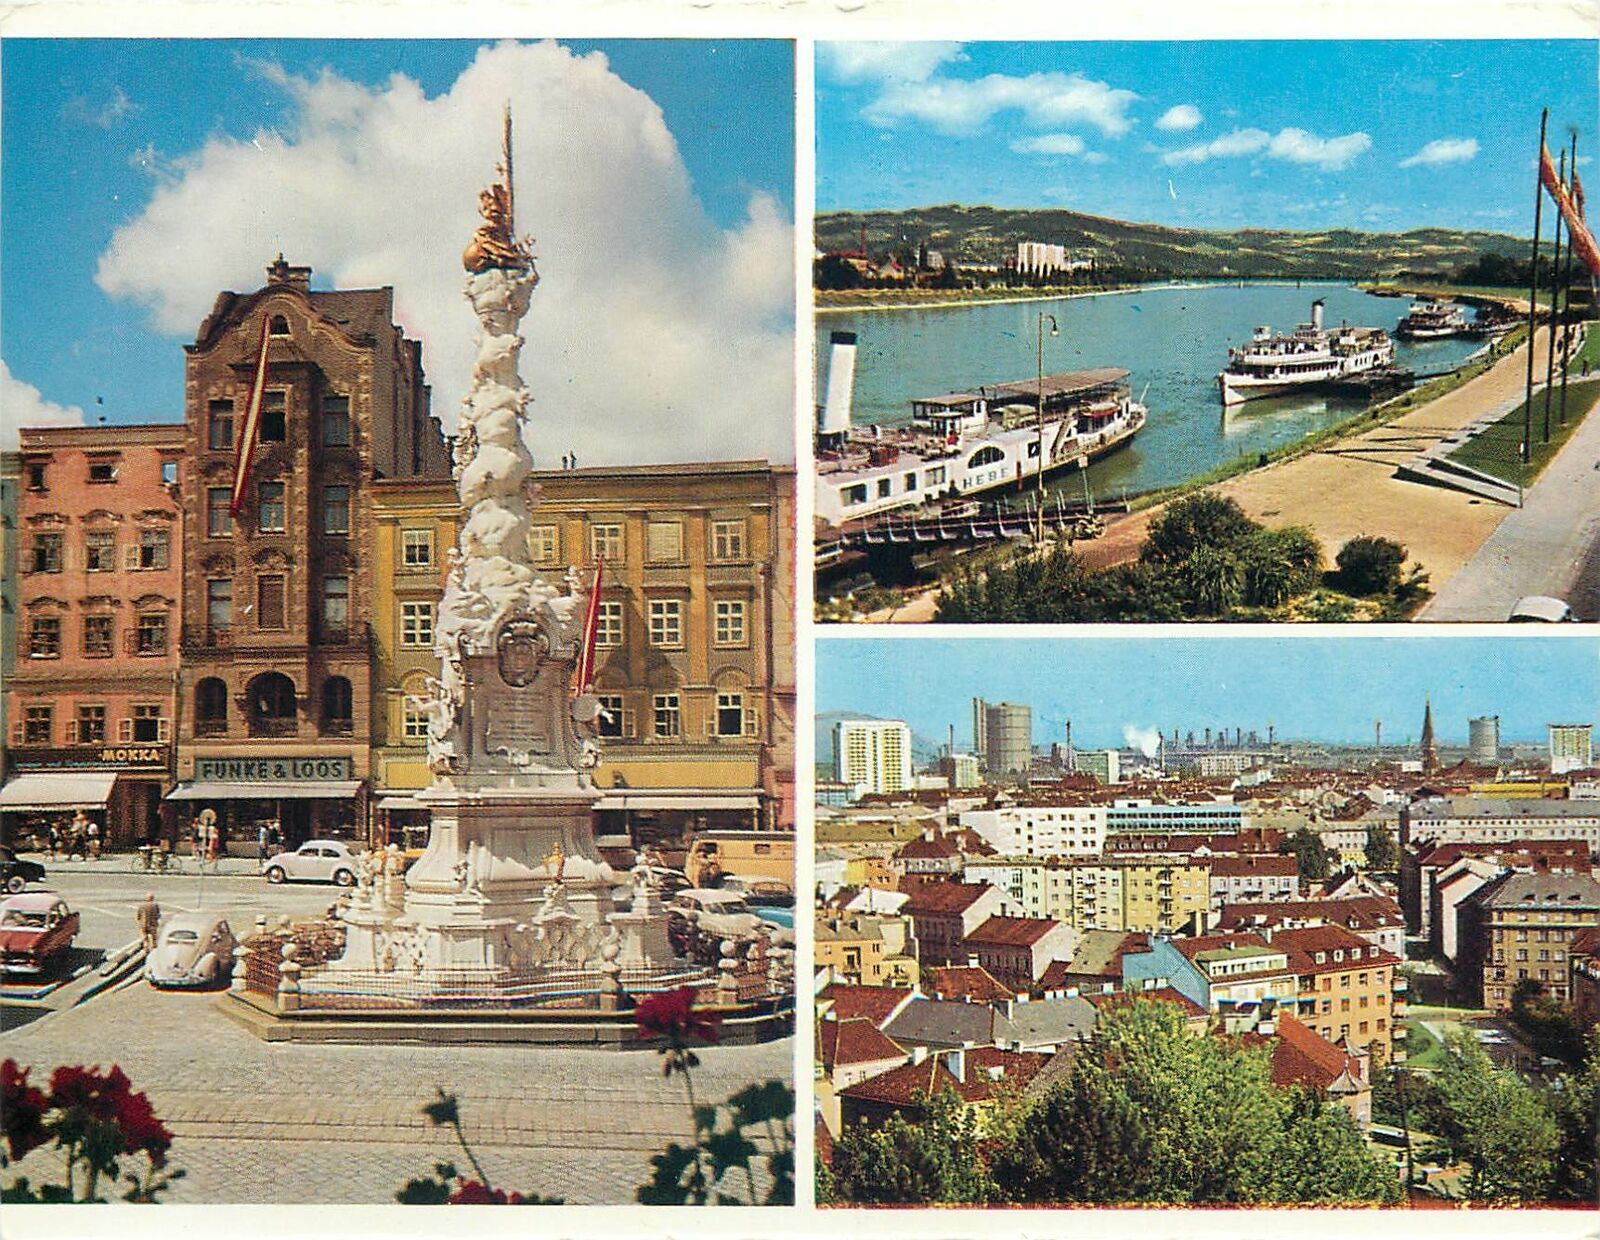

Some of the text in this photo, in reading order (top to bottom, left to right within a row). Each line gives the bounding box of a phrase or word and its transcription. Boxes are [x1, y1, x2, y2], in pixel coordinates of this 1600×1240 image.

[963, 467, 1009, 490] HEBE
[102, 749, 160, 762] MOKKA
[202, 761, 343, 780] FUNKE & LOOS
